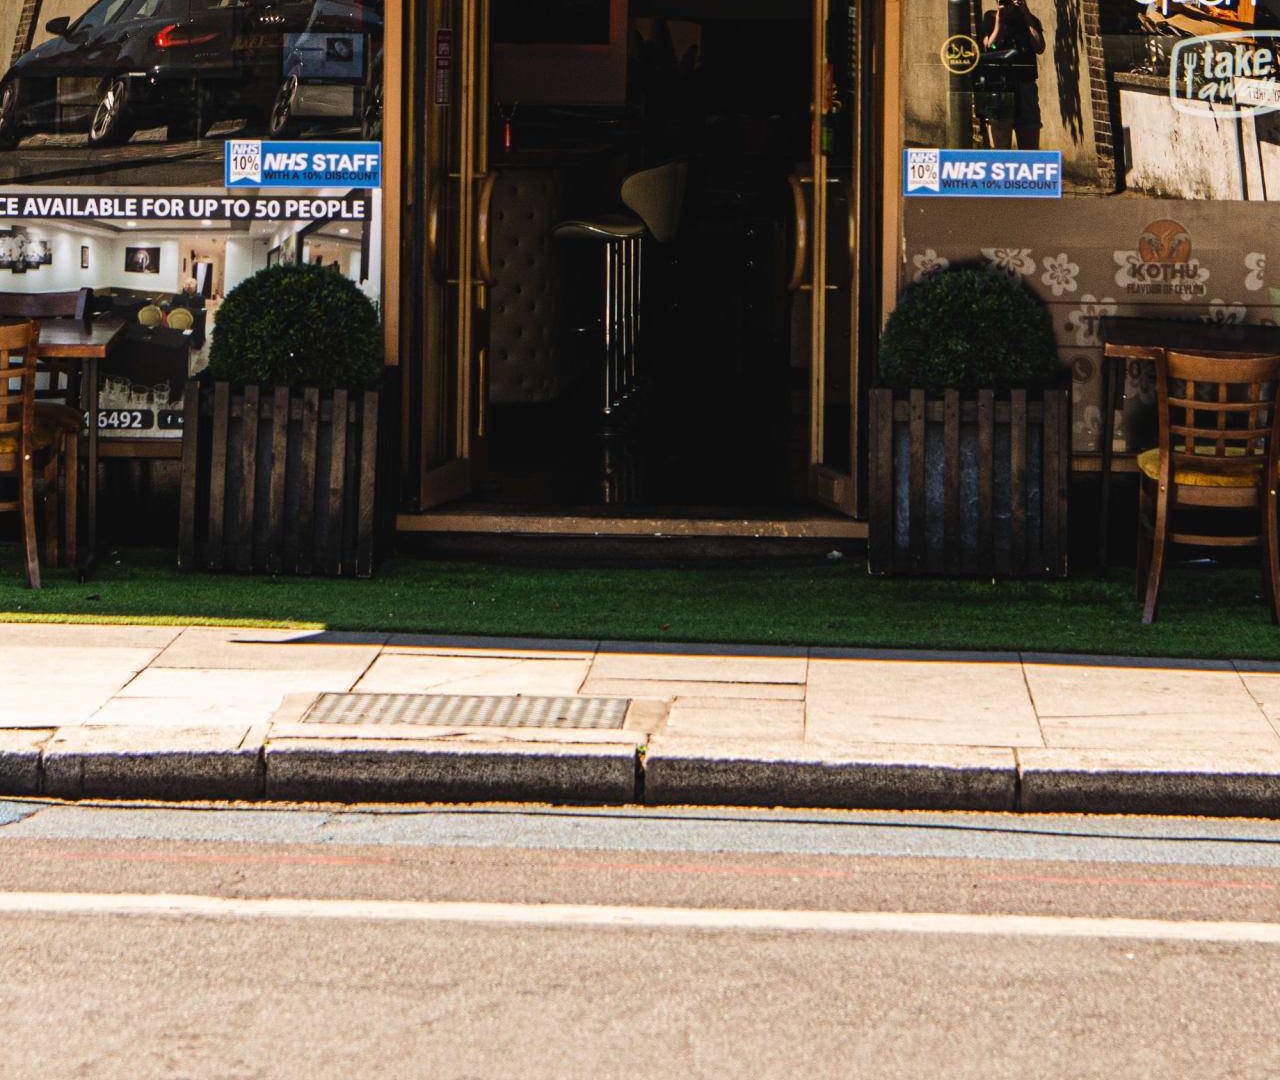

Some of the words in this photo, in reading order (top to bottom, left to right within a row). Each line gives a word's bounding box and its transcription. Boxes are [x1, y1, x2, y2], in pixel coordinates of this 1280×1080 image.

[1203, 41, 1273, 79] take
[232, 143, 260, 155] NHS
[233, 155, 259, 171] 10%
[263, 152, 309, 171] NHS
[312, 153, 379, 172] STAFF
[910, 152, 937, 164] NHS
[264, 171, 290, 180] WITH
[292, 172, 300, 180] A
[303, 172, 322, 180] 10%
[325, 172, 378, 181] DISCOUNT
[910, 165, 937, 180] 10%
[941, 161, 987, 180] NHS
[991, 163, 1059, 181] STAFF
[942, 180, 969, 189] WITH
[970, 180, 978, 189] A
[981, 180, 1001, 189] 10%
[1004, 181, 1058, 190] DISCOUNT
[23, 197, 137, 217] AVAILABLE
[141, 198, 184, 218] FOR
[189, 199, 219, 218] UP
[221, 199, 250, 218] TO
[254, 199, 281, 218] 50
[285, 199, 365, 219] PEOPLE
[1131, 263, 1199, 281] KOTHU
[1127, 283, 1162, 295] FLAVOUR
